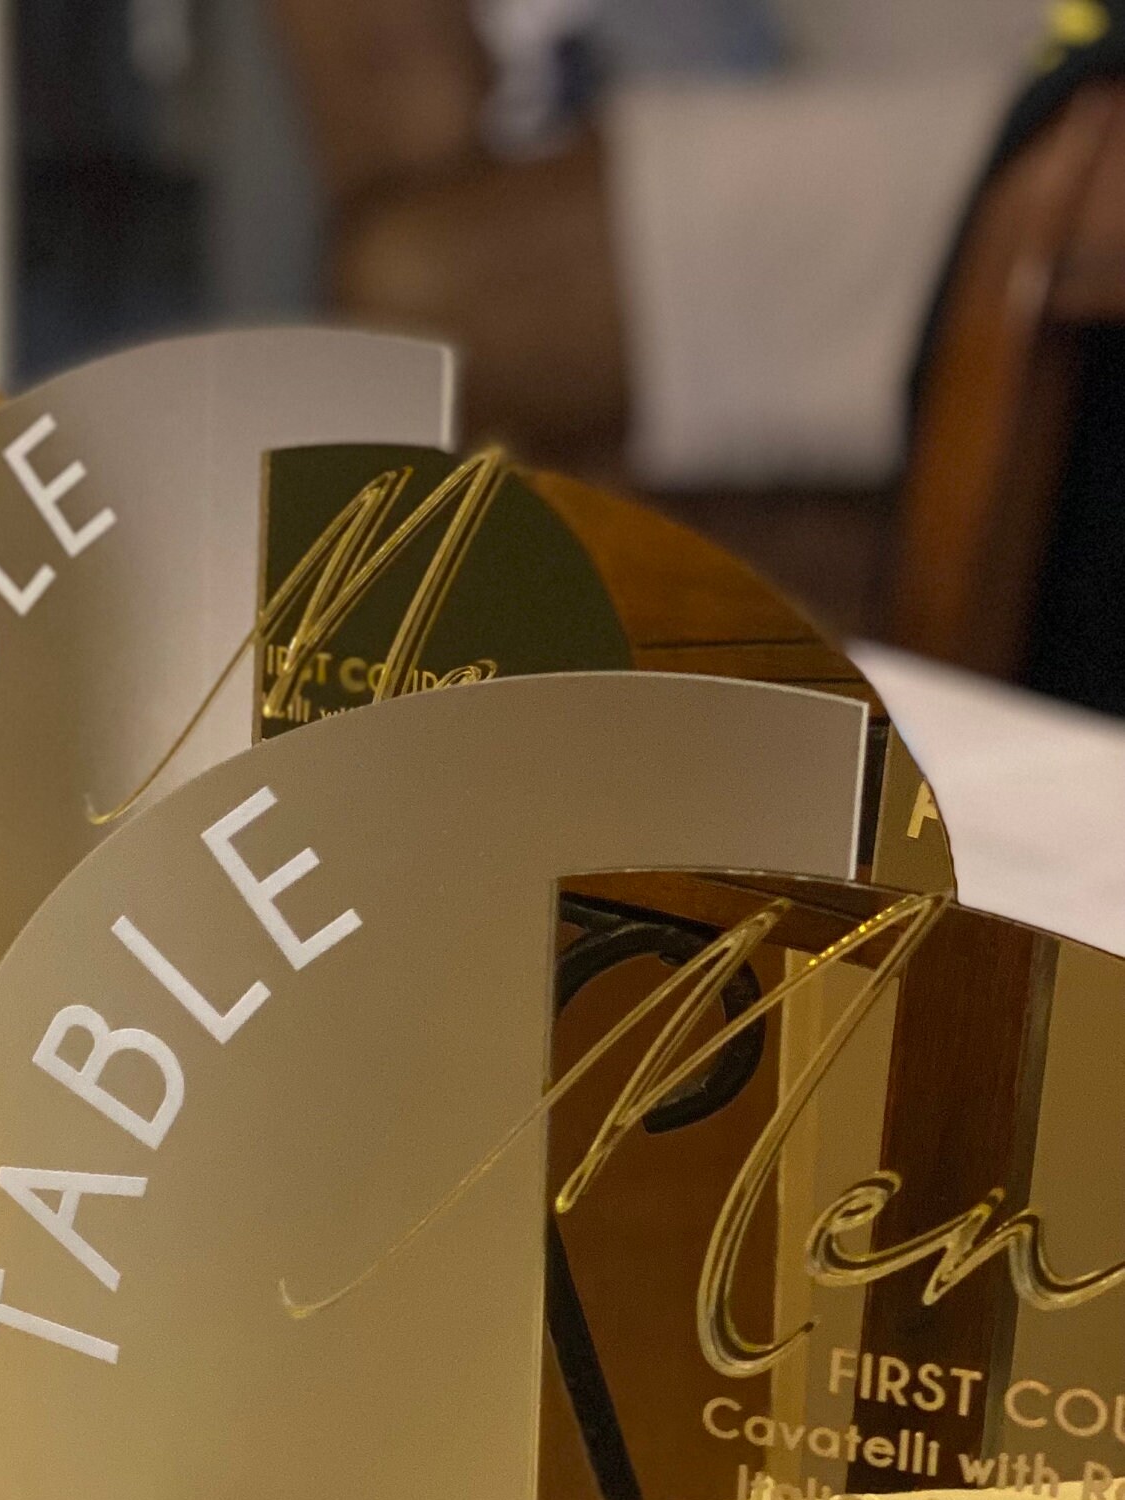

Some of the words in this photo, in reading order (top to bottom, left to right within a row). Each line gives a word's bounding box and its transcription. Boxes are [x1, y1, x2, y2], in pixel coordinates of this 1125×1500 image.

[828, 1348, 982, 1416] FIRST
[1005, 1379, 1125, 1444] CO
[702, 1396, 939, 1476] Cavatelli
[959, 1453, 1059, 1498] with
